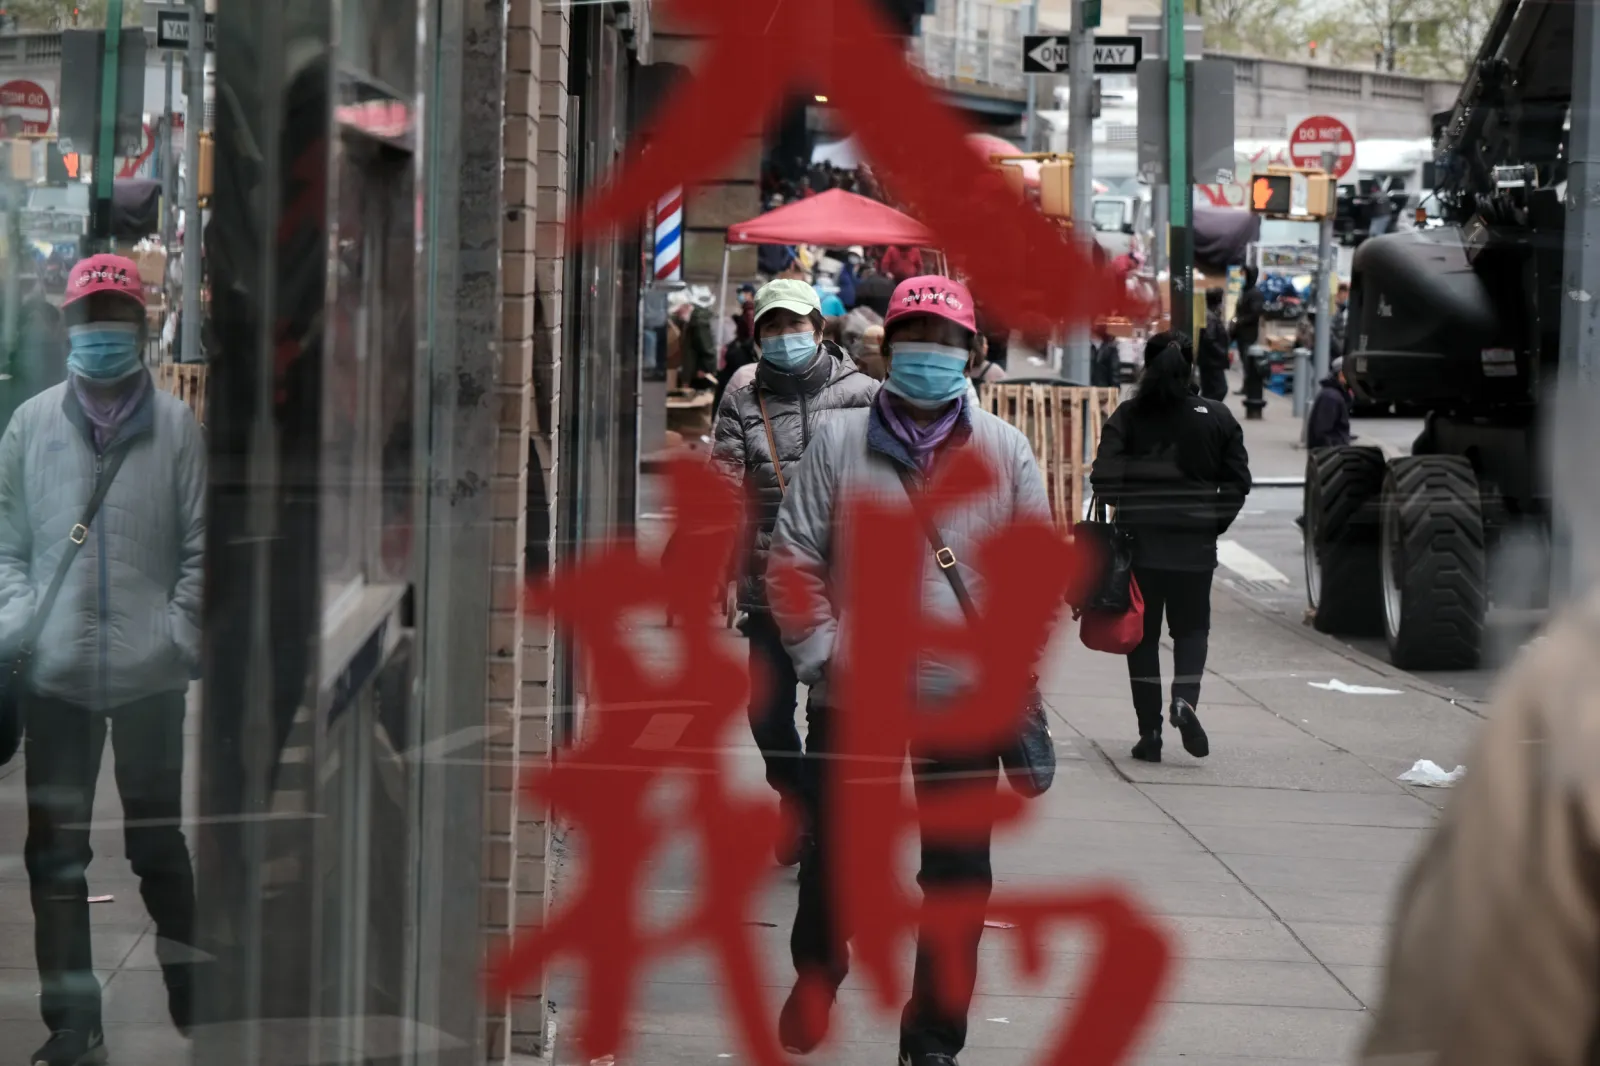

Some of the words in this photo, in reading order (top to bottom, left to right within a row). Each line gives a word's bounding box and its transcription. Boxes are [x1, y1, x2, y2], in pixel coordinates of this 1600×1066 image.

[1040, 47, 1070, 63] ON
[1092, 47, 1127, 64] WAY
[1299, 127, 1315, 141] DO
[901, 295, 921, 304] new
[921, 292, 945, 302] york
[905, 286, 959, 311] NYC
